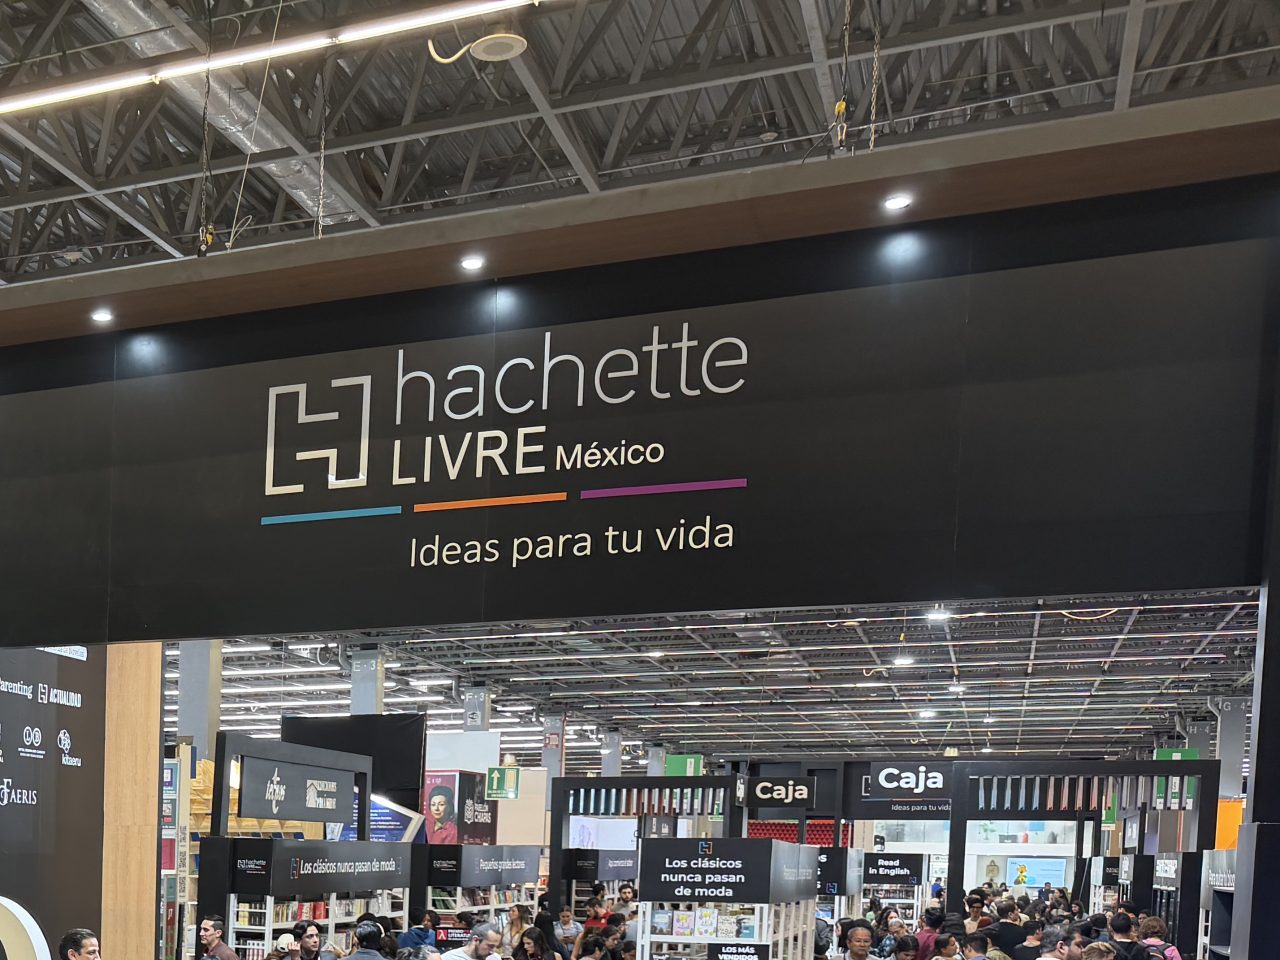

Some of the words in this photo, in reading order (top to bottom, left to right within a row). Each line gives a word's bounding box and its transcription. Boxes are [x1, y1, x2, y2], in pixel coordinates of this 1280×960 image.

[394, 321, 750, 426] hachette
[392, 425, 547, 486] LIVRE
[555, 439, 665, 472] México
[409, 535, 500, 568] Ideas
[511, 529, 593, 568] para
[604, 523, 643, 555] tu
[655, 515, 735, 552] vida
[49, 688, 82, 707] ACTUALIDAD
[878, 766, 944, 793] Caja
[755, 780, 808, 803] Caja
[911, 805, 927, 813] para
[300, 860, 312, 874] Los
[313, 858, 337, 874] clásicos
[337, 861, 355, 873] nunca
[355, 861, 371, 876] pasan
[371, 859, 380, 872] de
[380, 858, 396, 871] moda
[665, 857, 687, 868] Los
[690, 856, 742, 869] clásicos
[661, 873, 702, 883] nunca
[705, 873, 745, 885] pasan
[879, 867, 910, 877] English
[675, 886, 691, 896] de
[695, 886, 733, 897] moda
[738, 945, 755, 953] MÁS
